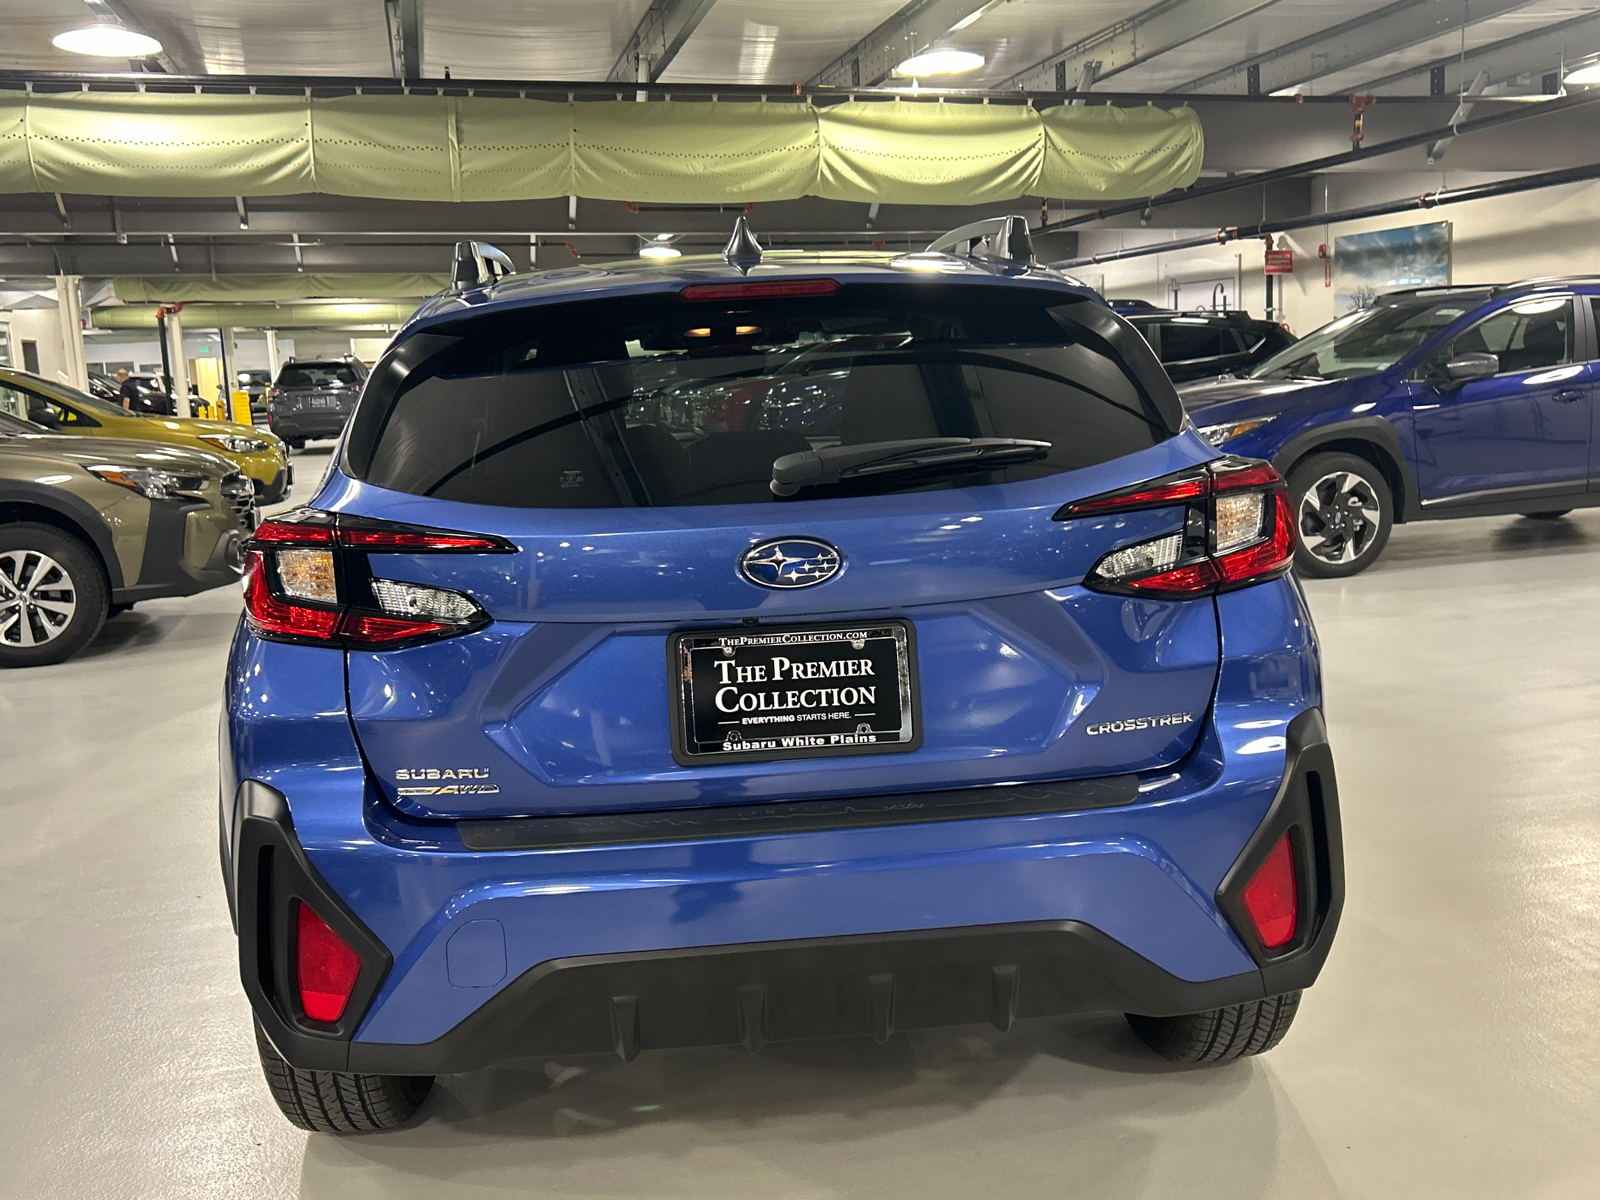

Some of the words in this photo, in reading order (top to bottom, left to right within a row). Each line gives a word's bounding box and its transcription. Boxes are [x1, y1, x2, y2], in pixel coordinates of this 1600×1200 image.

[714, 659, 768, 685] THE
[771, 656, 875, 681] PREMIER
[714, 686, 877, 713] COLLECTION
[742, 715, 795, 725] EVERYTHING
[796, 713, 827, 722] STARTS
[828, 711, 852, 721] HERE.
[1086, 711, 1194, 735] CROSSTREK
[722, 739, 776, 751] Subaru
[781, 735, 825, 748] White
[830, 733, 877, 746] Plains
[395, 767, 490, 780] SUBARU
[434, 784, 499, 795] AWD
